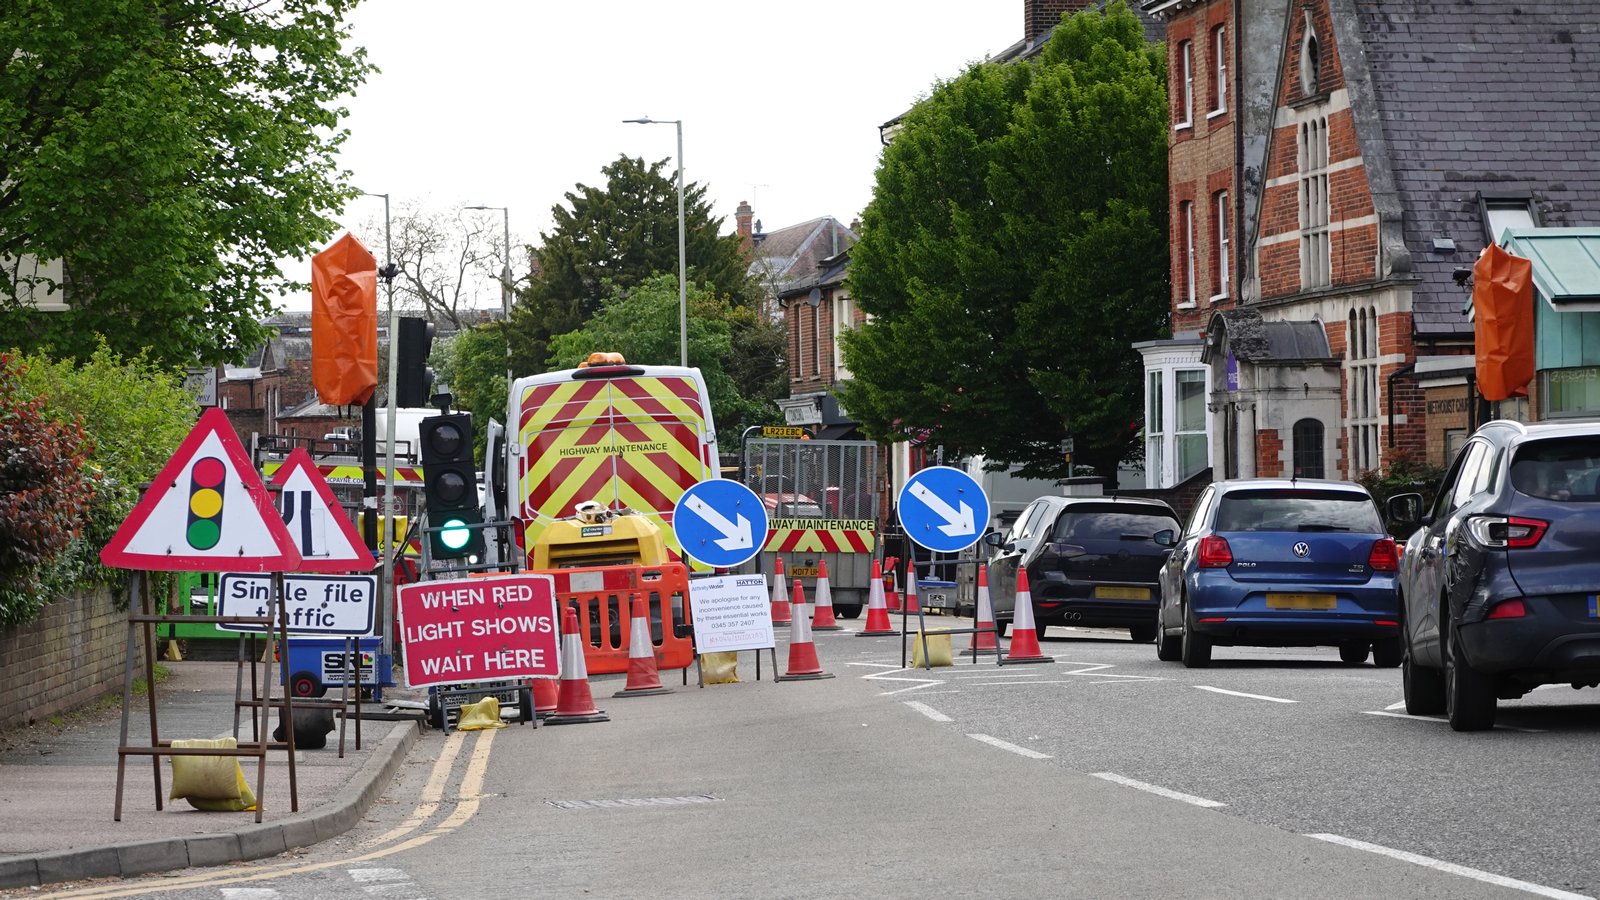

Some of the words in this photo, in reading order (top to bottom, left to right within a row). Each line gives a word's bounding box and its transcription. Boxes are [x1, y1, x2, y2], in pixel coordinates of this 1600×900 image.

[559, 447, 601, 456] HIGHWAY
[603, 442, 668, 453] MAINTENANCE
[797, 519, 874, 531] MAINTENANCE
[231, 580, 308, 602] Sinle
[323, 583, 364, 603] file
[420, 588, 485, 609] WHEN
[492, 585, 533, 603] RED
[256, 606, 336, 627] taffic
[699, 605, 741, 613] inconvenience
[407, 620, 465, 643] LIGHT
[471, 616, 552, 636] SHOWS
[324, 653, 373, 669] SRL
[420, 654, 474, 676] WAIT
[483, 649, 546, 671] HERE
